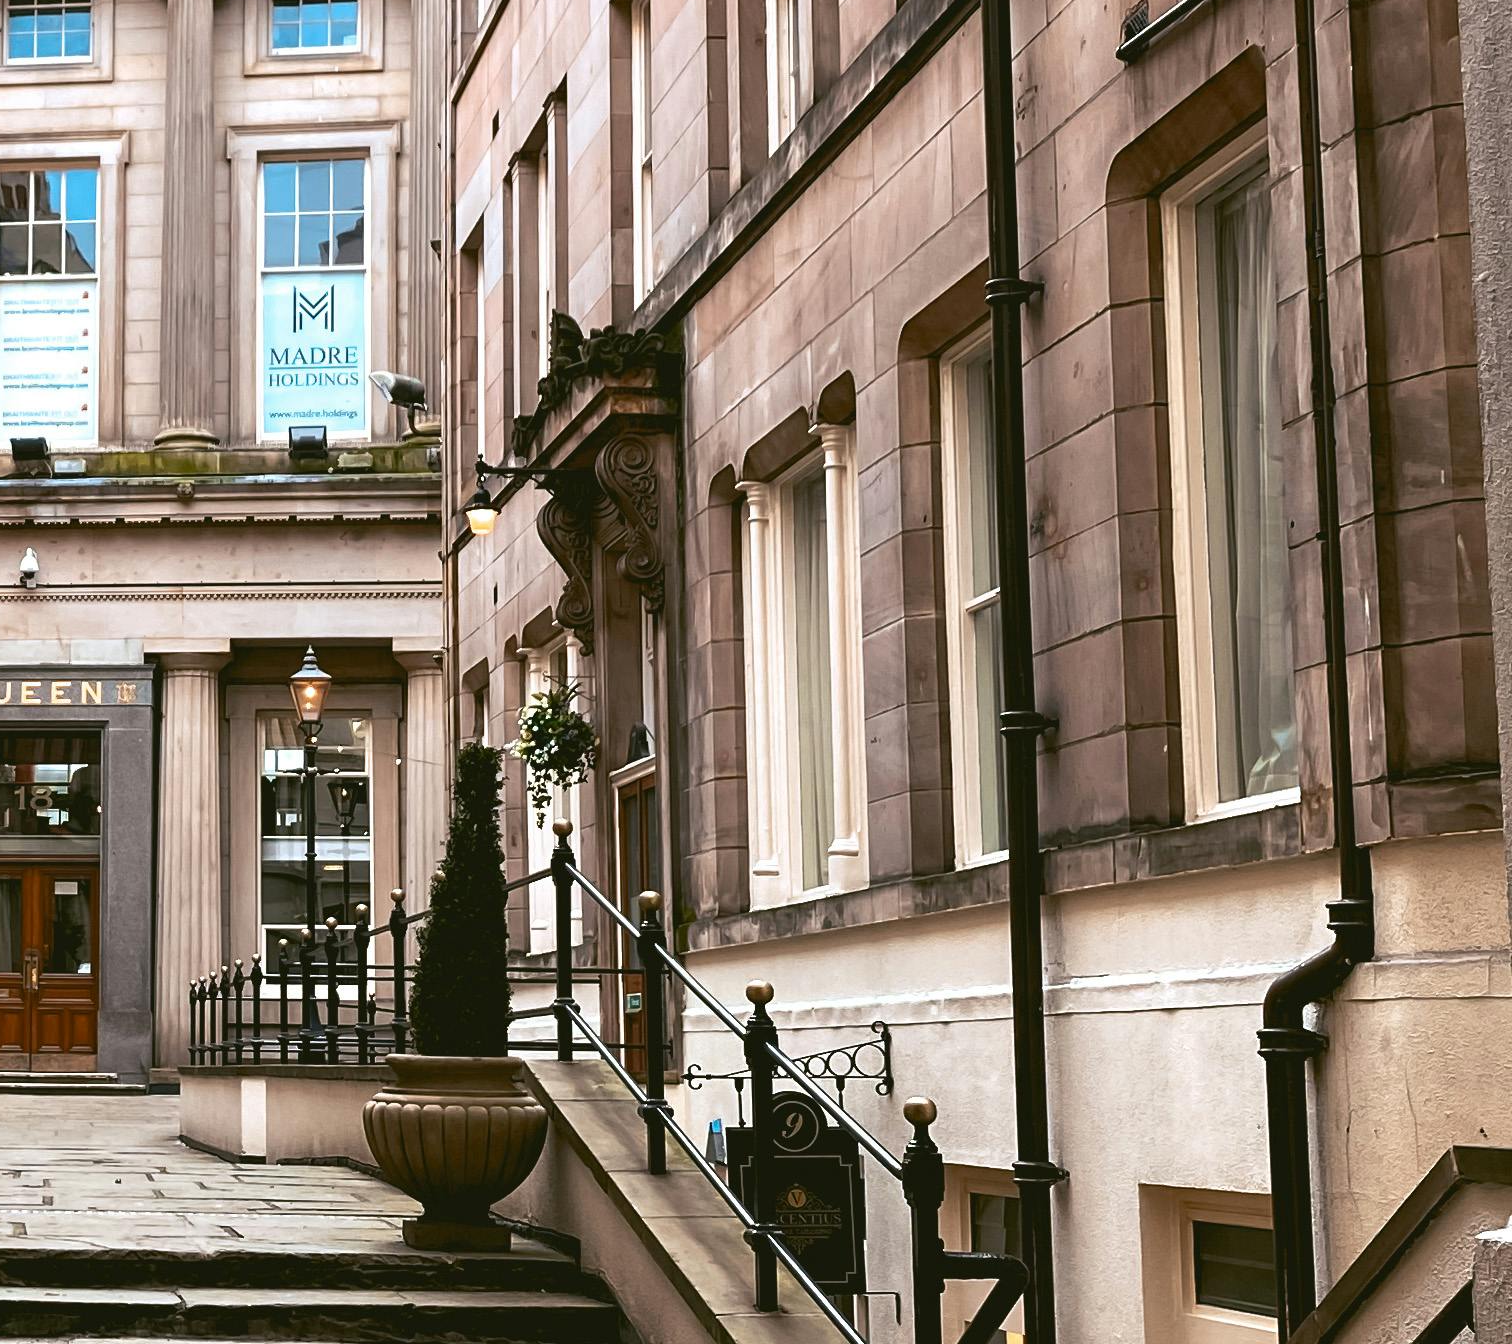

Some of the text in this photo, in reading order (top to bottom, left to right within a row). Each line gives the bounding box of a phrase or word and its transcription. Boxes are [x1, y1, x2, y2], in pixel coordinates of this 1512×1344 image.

[270, 346, 358, 366] MADRE
[269, 372, 359, 387] HOLDINGS
[269, 409, 358, 419] www.madre.holdings
[14, 786, 53, 810] 18
[781, 1112, 803, 1139] 9
[791, 1191, 802, 1205] V
